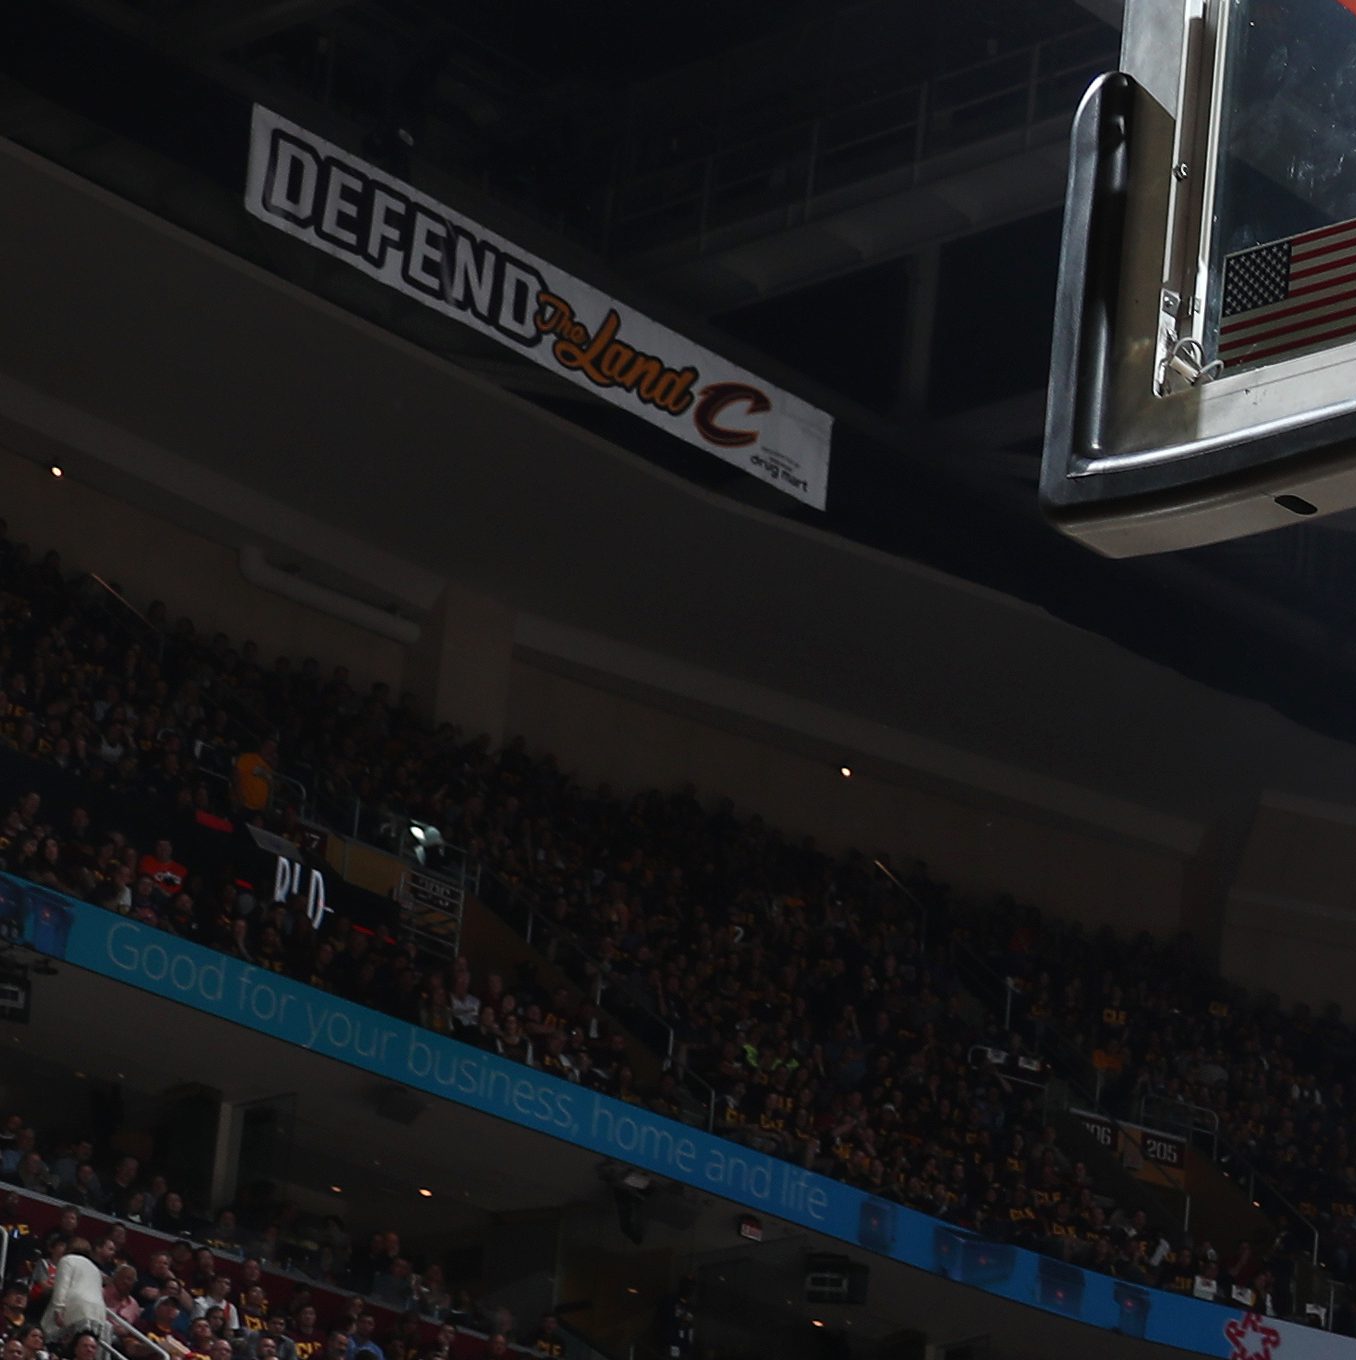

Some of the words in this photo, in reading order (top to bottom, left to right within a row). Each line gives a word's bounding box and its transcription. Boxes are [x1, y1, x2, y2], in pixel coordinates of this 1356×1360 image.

[266, 134, 546, 343] DEFEND
[535, 292, 588, 345] The
[553, 308, 698, 415] Land
[694, 382, 771, 447] C
[106, 921, 227, 1001] Good
[239, 967, 297, 1024] for
[302, 1000, 399, 1062] your
[406, 1026, 580, 1137] business,
[591, 1104, 697, 1174] home
[704, 1148, 773, 1199] and
[781, 1161, 829, 1221] life
[1145, 1139, 1179, 1163] 205
